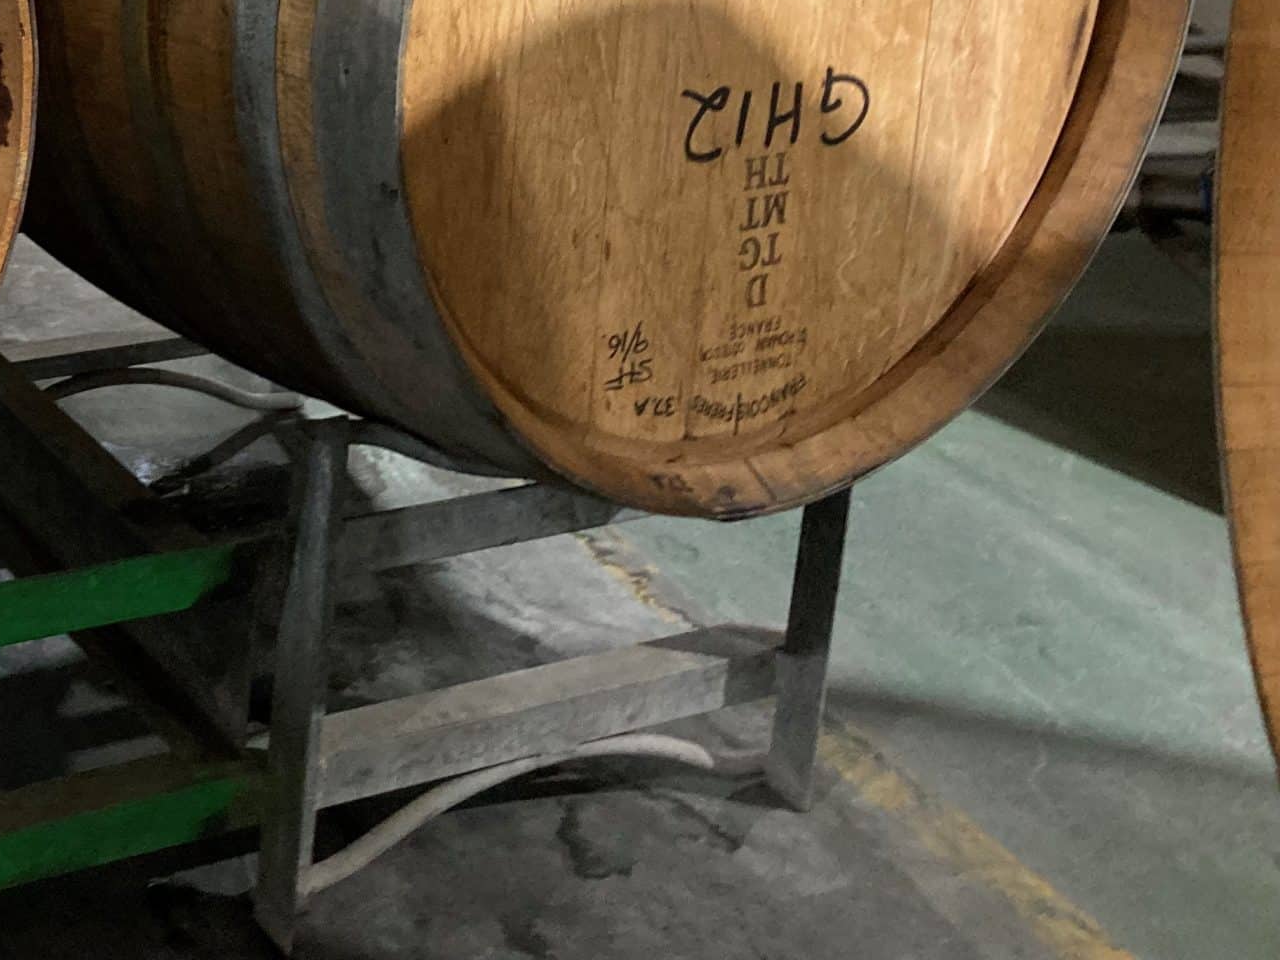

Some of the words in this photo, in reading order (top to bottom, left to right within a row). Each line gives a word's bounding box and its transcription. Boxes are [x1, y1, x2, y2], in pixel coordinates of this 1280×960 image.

[681, 65, 870, 164] GH12
[743, 151, 790, 191] TH
[738, 190, 789, 232] MT
[738, 231, 783, 272] TG
[745, 273, 769, 310] D
[729, 315, 783, 341] FRANCE
